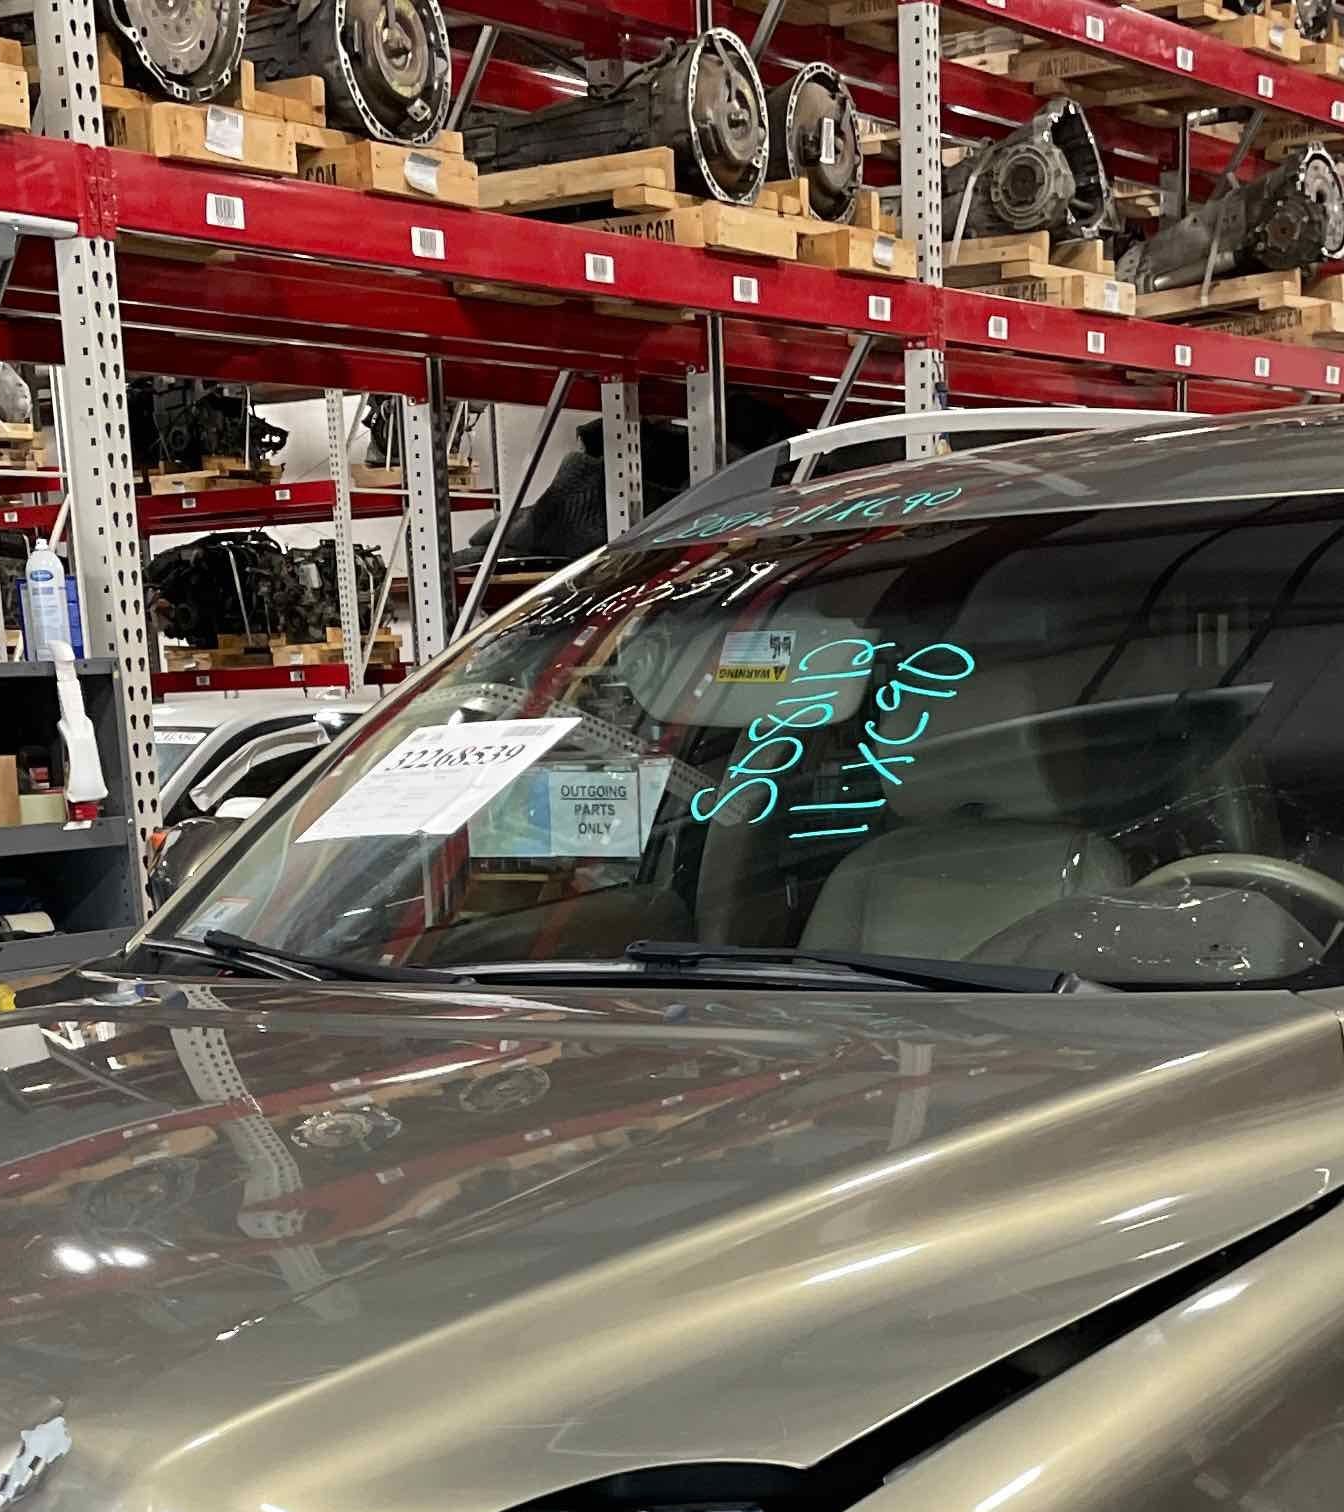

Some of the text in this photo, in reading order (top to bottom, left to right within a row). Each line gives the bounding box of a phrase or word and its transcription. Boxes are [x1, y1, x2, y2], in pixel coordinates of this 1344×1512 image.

[384, 743, 526, 771] 32268539
[560, 784, 627, 798] OUTGOING
[574, 803, 616, 816] PARTS
[578, 822, 612, 835] ONLY
